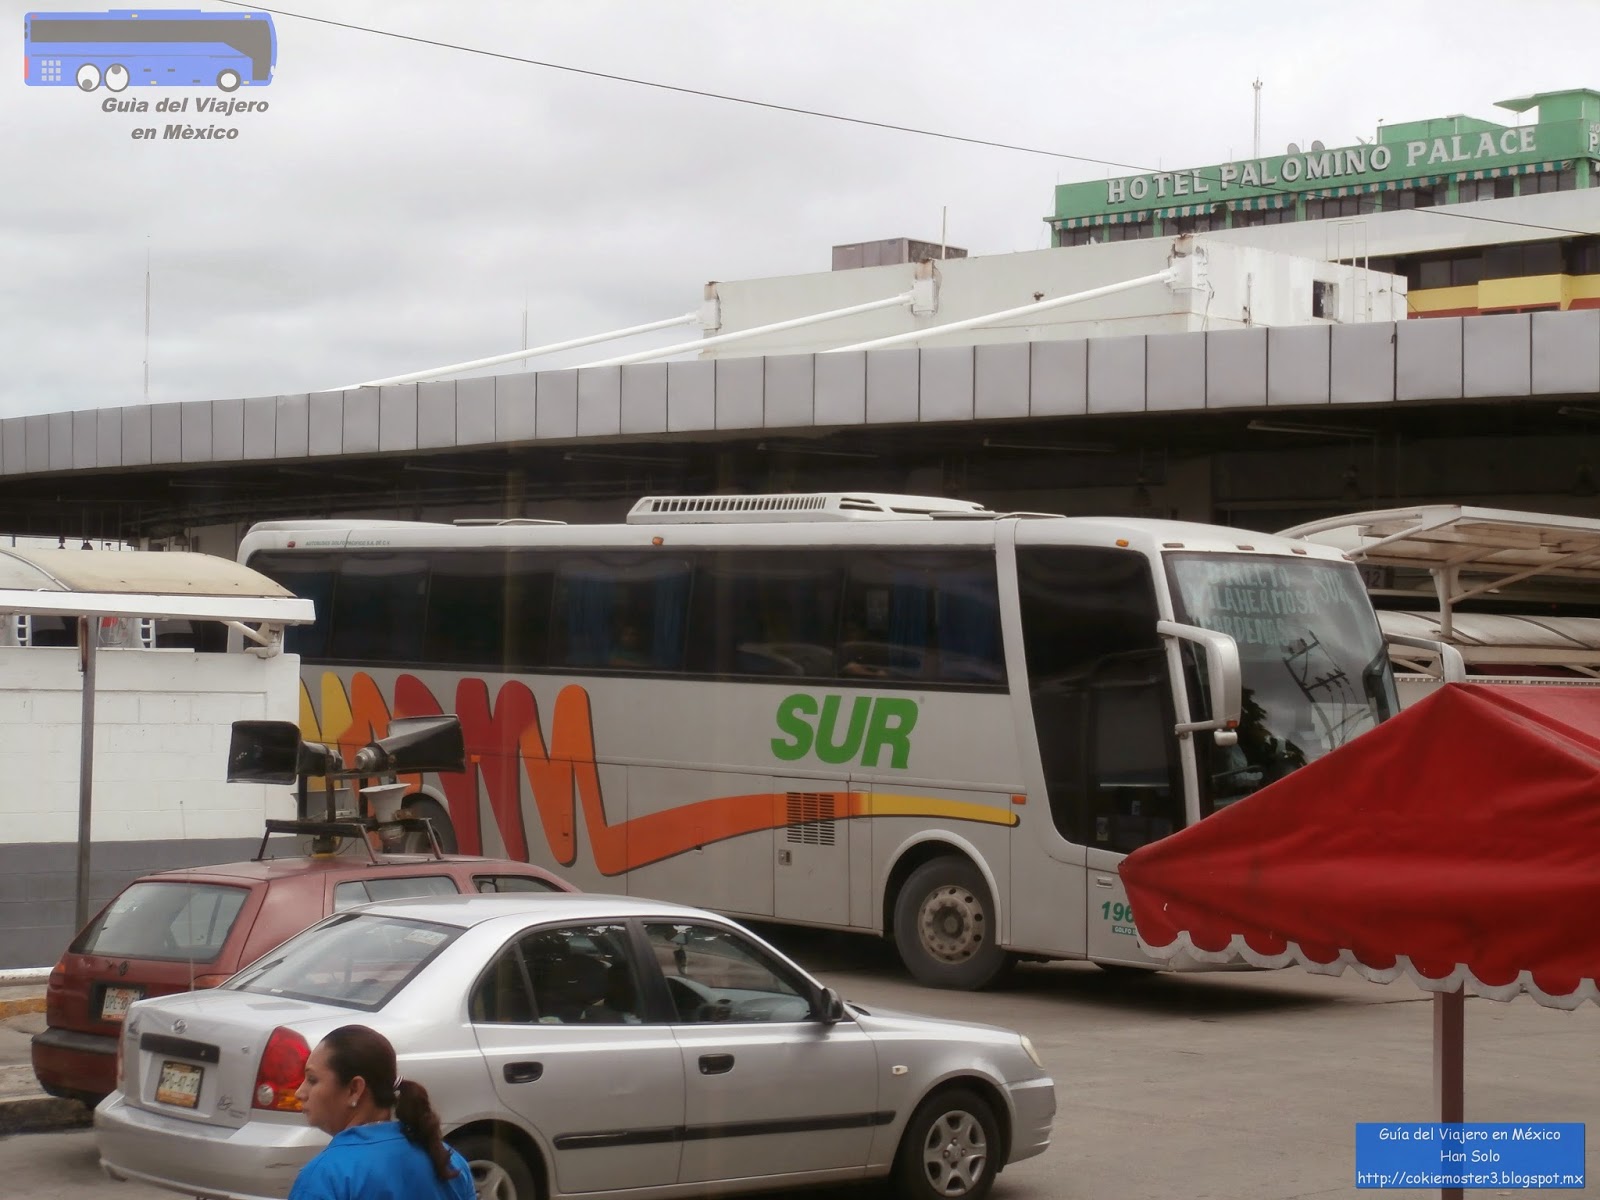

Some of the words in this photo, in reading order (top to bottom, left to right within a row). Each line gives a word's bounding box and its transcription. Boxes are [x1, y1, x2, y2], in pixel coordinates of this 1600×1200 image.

[1107, 169, 1209, 204] HOTEL
[1220, 145, 1391, 190] PALOMINO
[1406, 126, 1536, 167] PALACE
[771, 693, 918, 769] SUR
